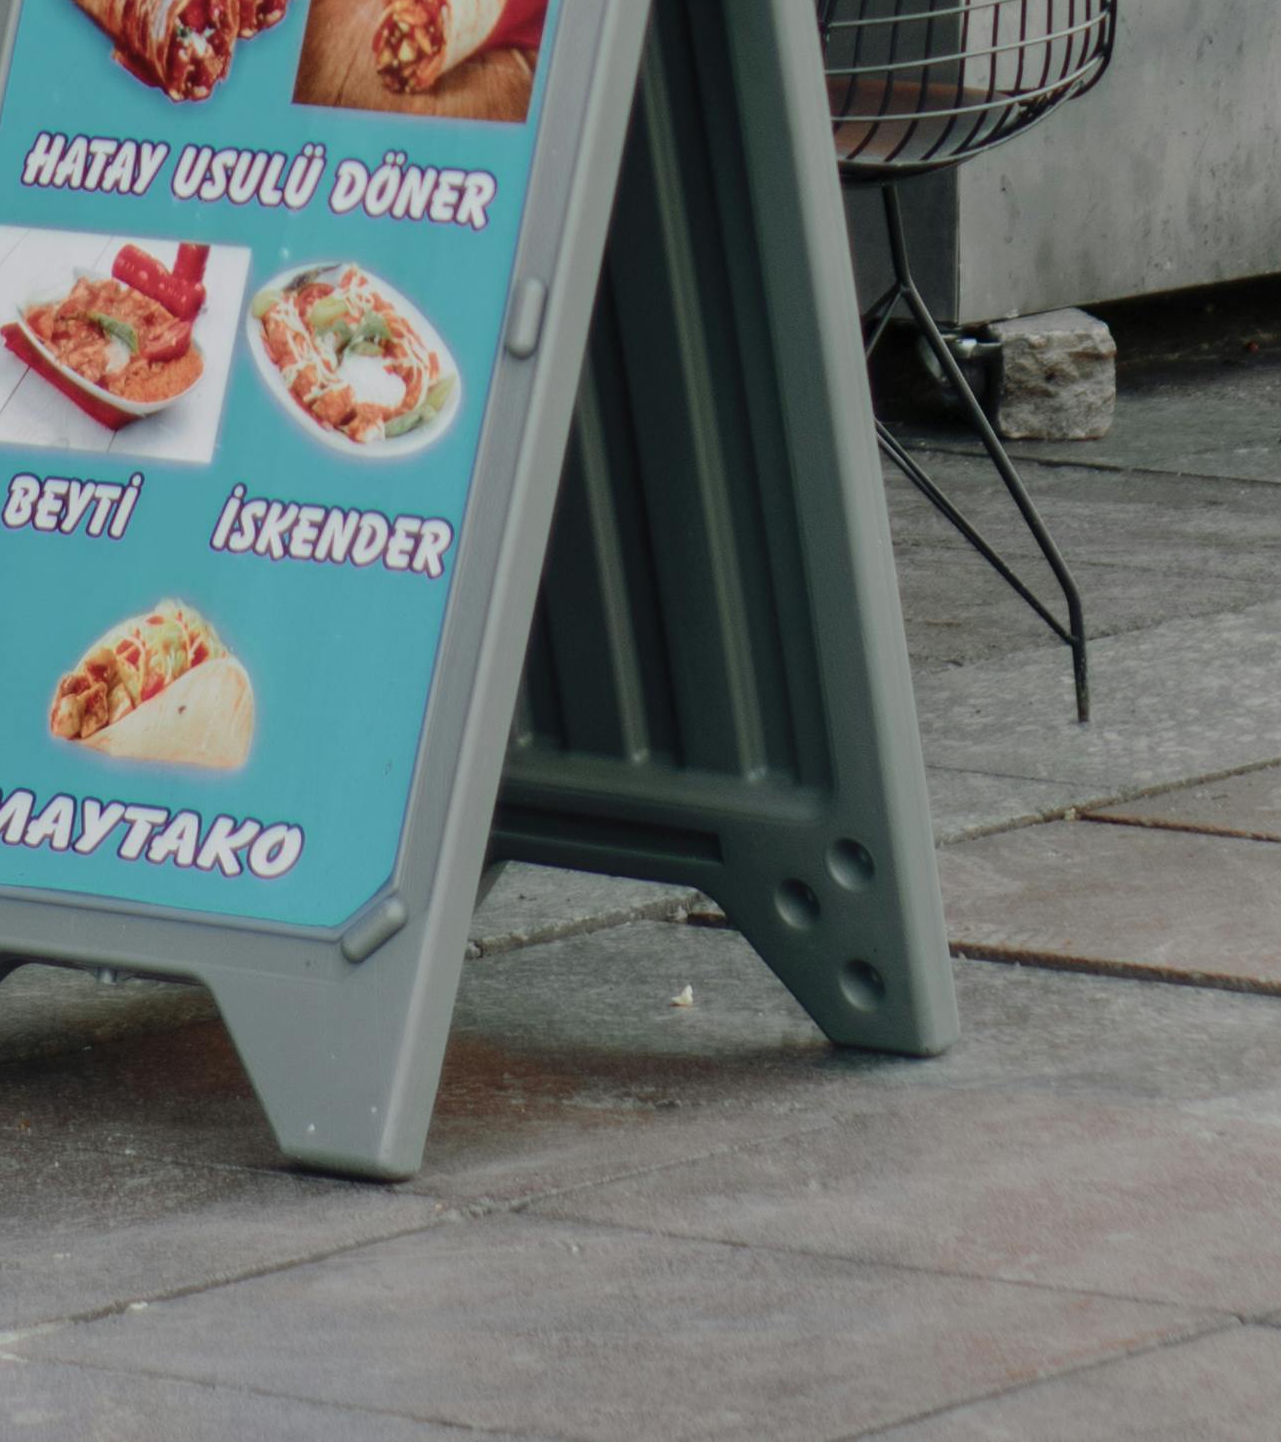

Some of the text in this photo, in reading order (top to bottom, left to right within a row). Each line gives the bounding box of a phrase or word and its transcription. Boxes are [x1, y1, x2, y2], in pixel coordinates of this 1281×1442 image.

[21, 132, 498, 231] HATAY USULÜ DÖNER
[2, 472, 454, 579] BEYTİ İSKENDER
